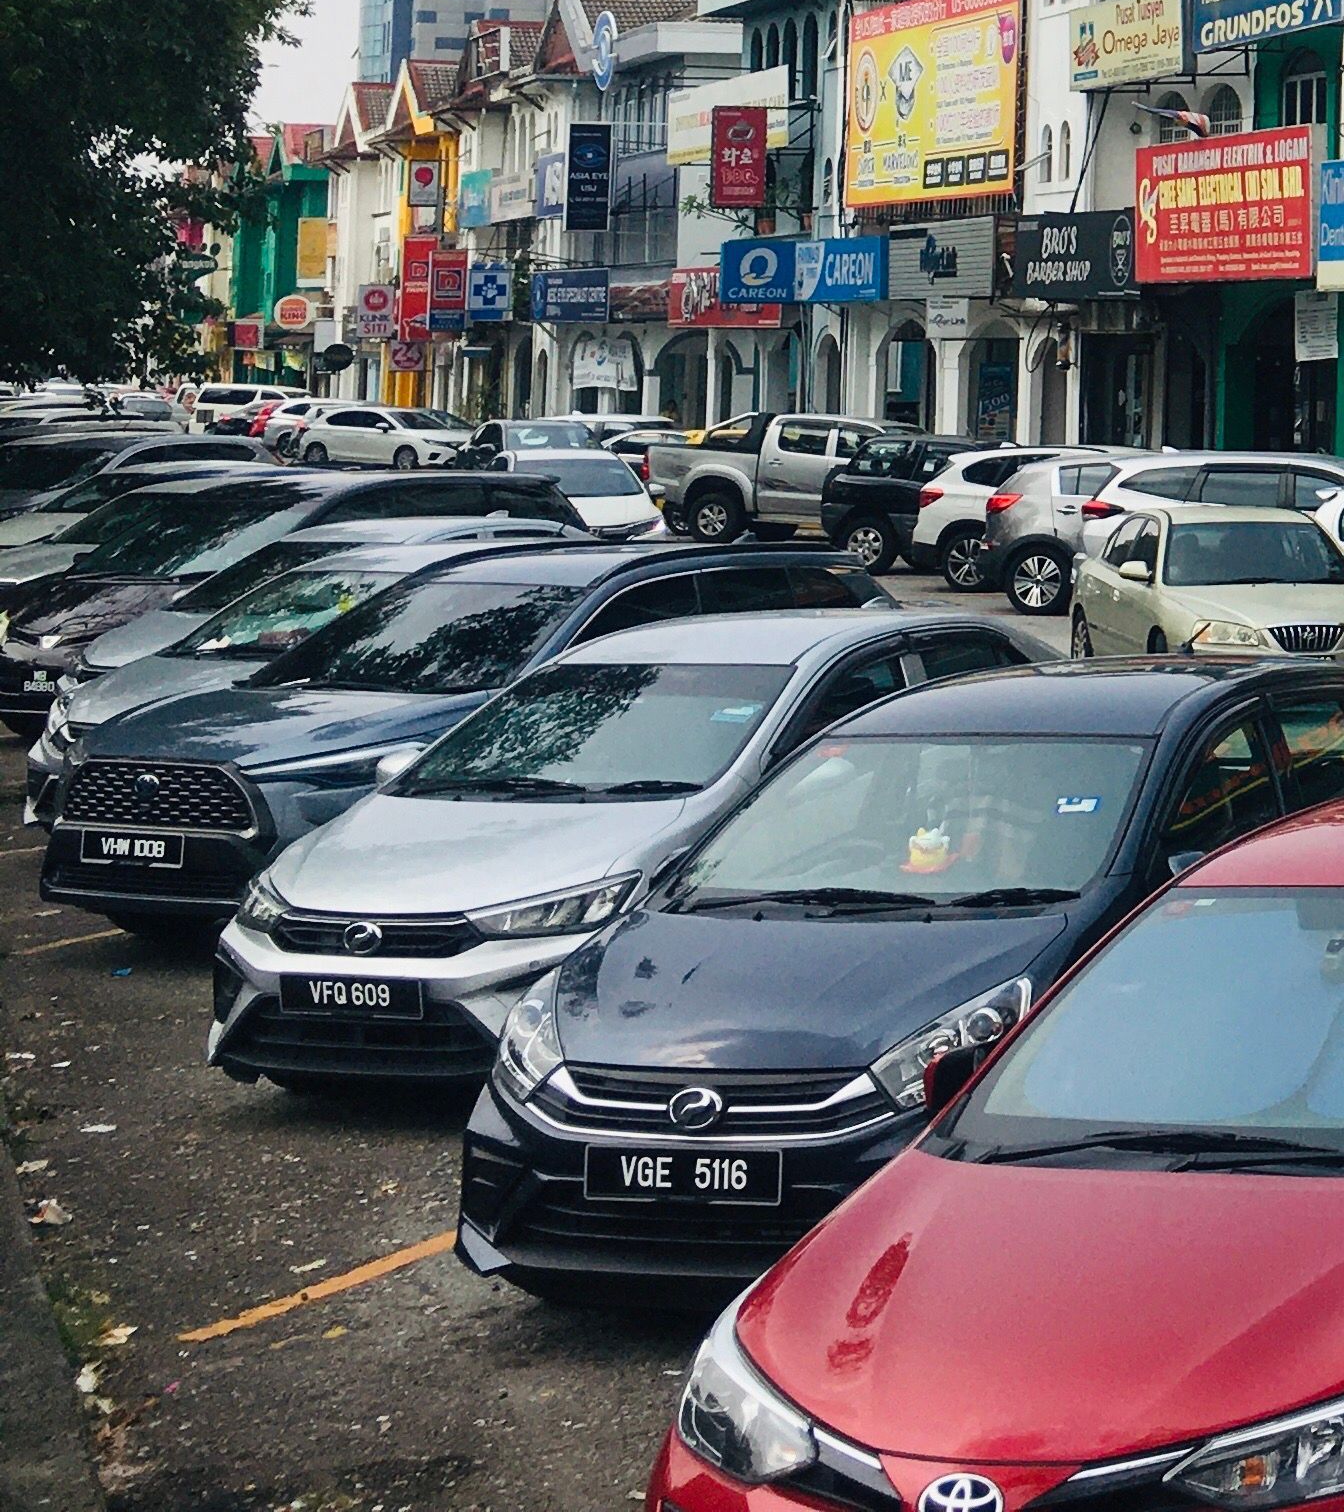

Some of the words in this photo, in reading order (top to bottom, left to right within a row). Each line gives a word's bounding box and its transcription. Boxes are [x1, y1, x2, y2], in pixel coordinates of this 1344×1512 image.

[1115, 3, 1135, 26] Pusat
[1137, 0, 1164, 23] Tuisyen
[1201, 0, 1304, 47] GRUNDFOS
[1102, 29, 1148, 55] Omega
[1152, 24, 1180, 50] Jaya
[1153, 153, 1176, 177] PUSAT
[1177, 148, 1221, 174] BARANGAN
[1223, 142, 1265, 168] ELEKTRIK
[1275, 137, 1308, 162] LOGAM
[570, 172, 590, 180] ASIA
[1041, 225, 1078, 259] BRO'S
[825, 252, 875, 286] CAREON
[1026, 261, 1064, 285] BARBER
[1065, 260, 1091, 283] SHOP
[728, 287, 787, 298] CAREON
[101, 837, 130, 855] VHW
[134, 839, 165, 858] 1008
[309, 981, 347, 1005] VFQ
[351, 982, 390, 1007] 609
[620, 1155, 673, 1188] VGE
[694, 1158, 748, 1190] 5116
